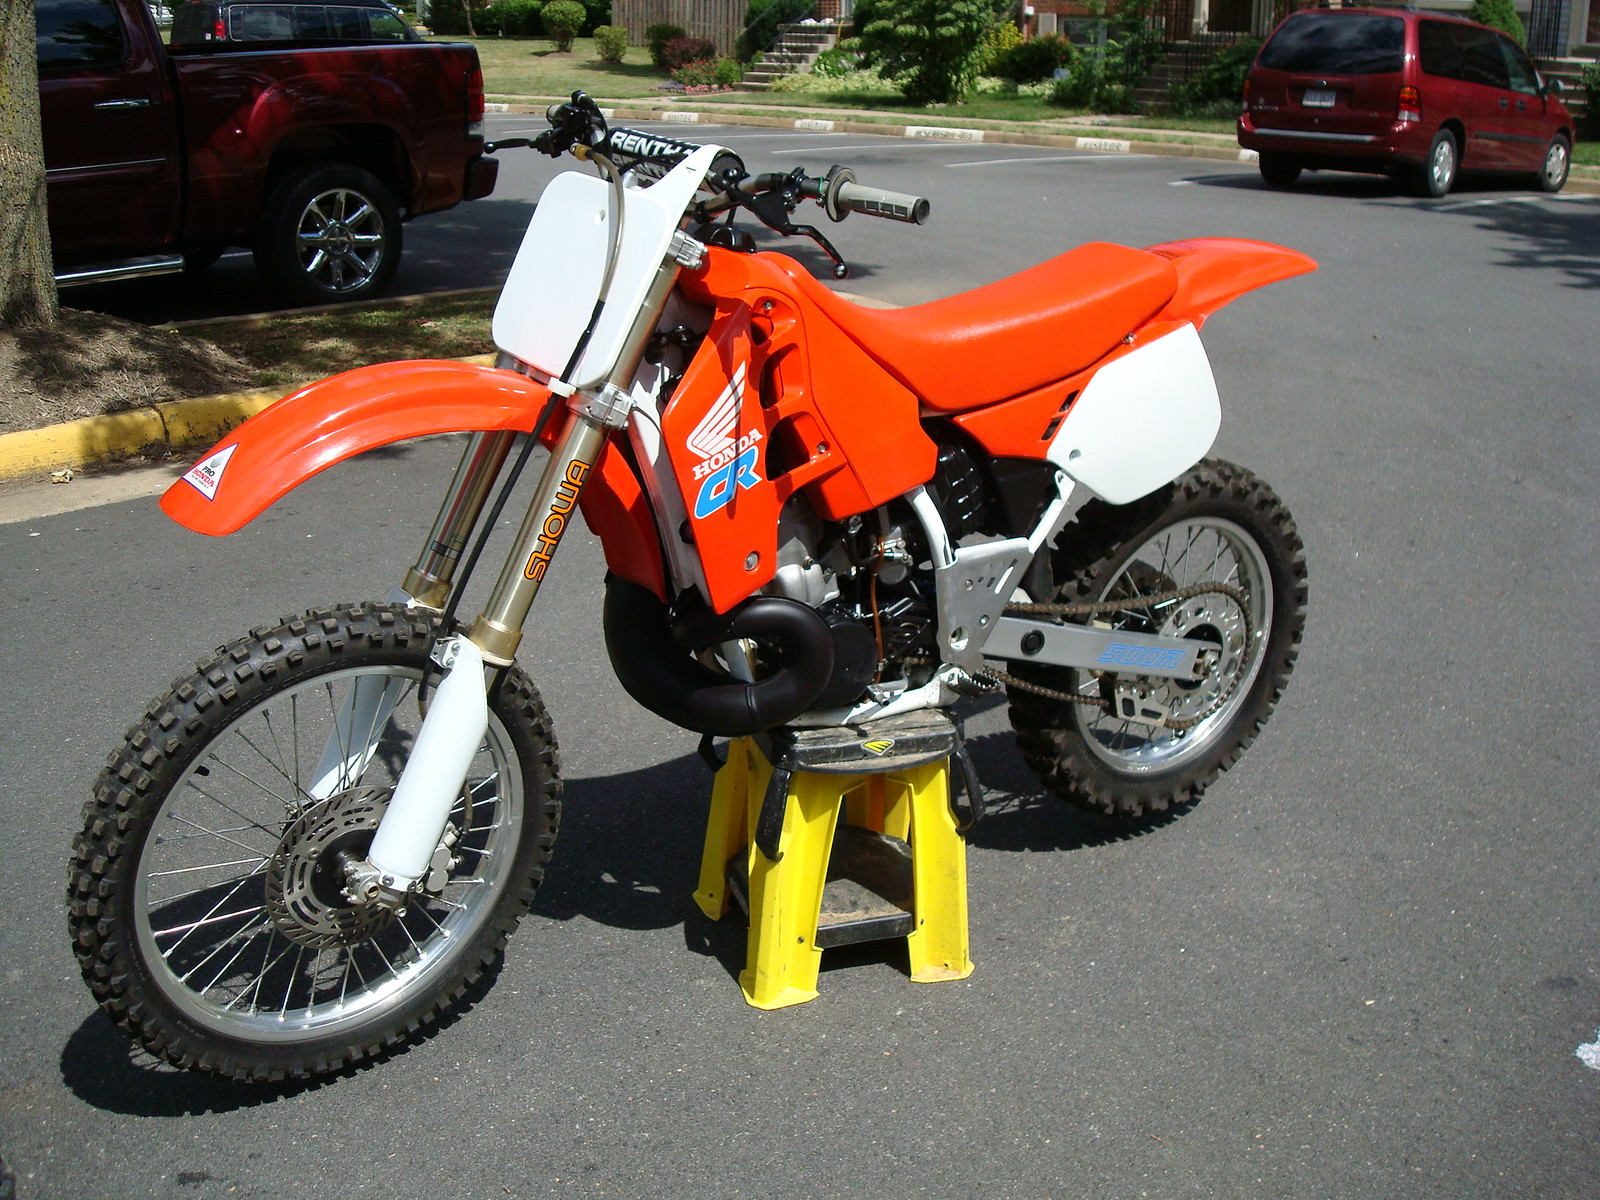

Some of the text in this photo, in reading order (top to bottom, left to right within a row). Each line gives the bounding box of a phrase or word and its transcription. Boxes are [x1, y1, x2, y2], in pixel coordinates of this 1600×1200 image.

[202, 466, 215, 477] PRO
[691, 428, 763, 481] HONDA
[193, 468, 215, 487] HONDA
[693, 445, 763, 519] CR
[523, 458, 591, 583] SHOWA
[1096, 642, 1187, 669] 500R
